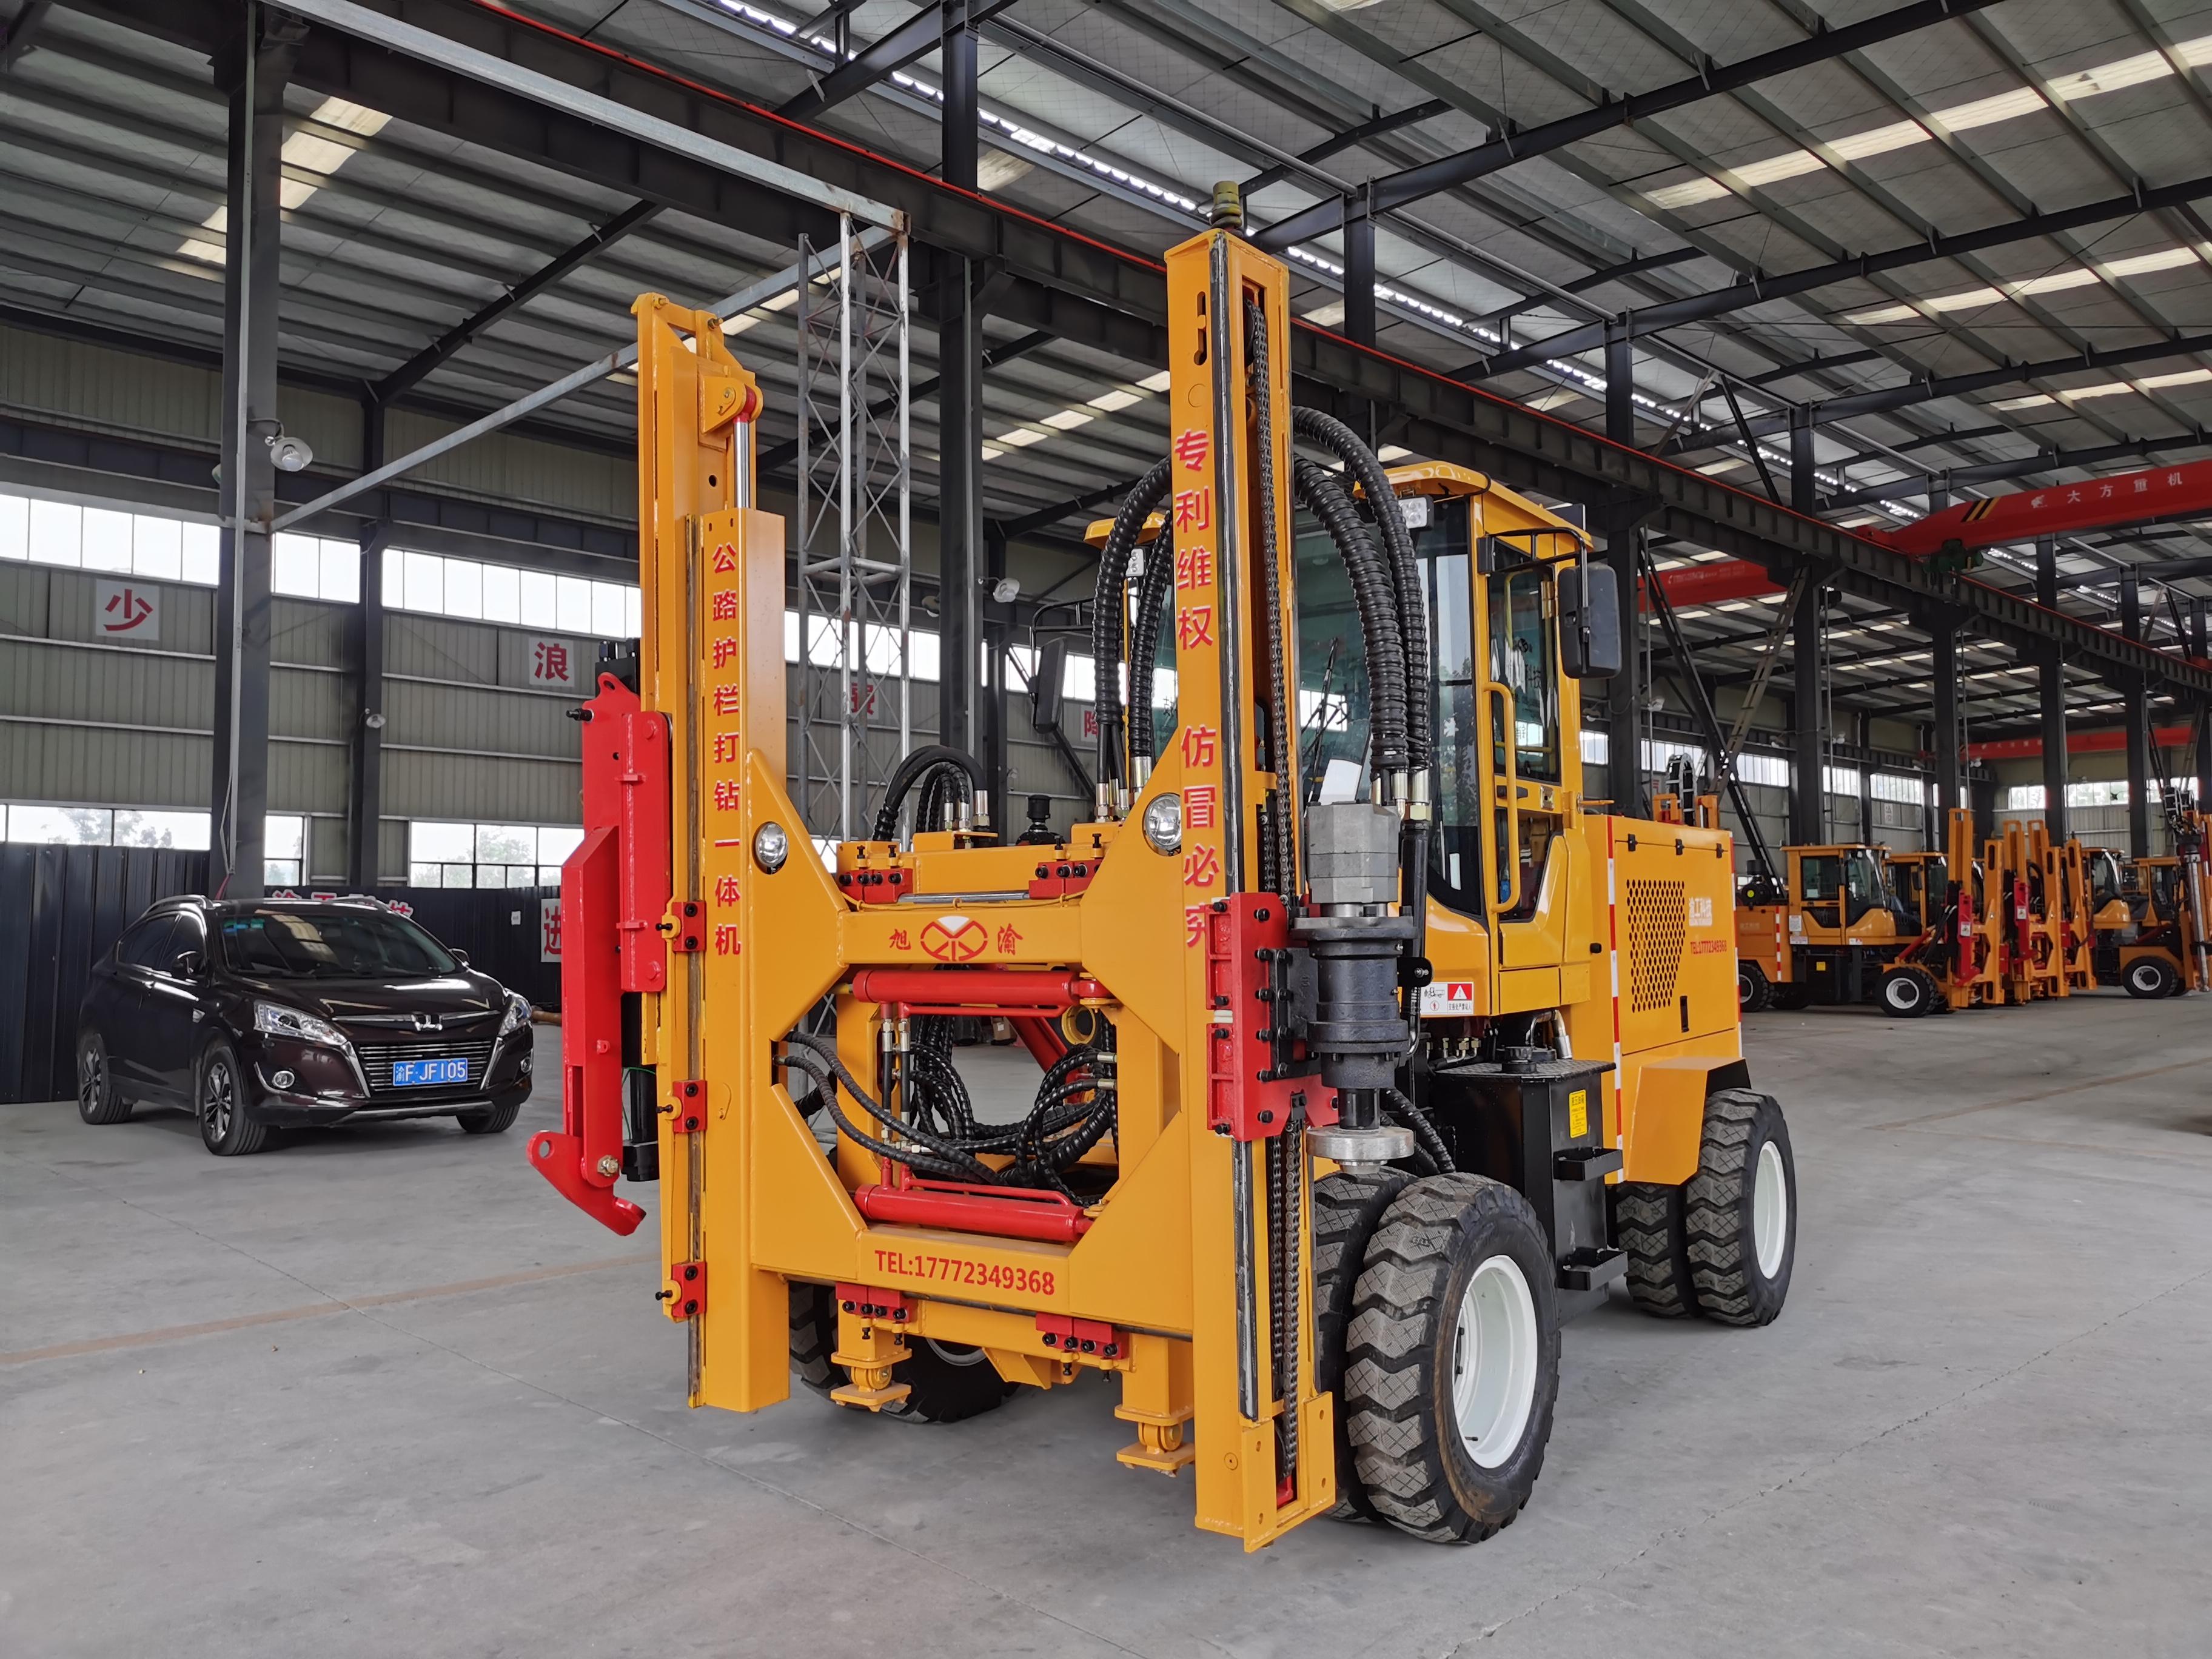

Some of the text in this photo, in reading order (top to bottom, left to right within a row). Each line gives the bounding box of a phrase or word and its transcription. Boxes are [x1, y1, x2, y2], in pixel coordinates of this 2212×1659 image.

[2066, 472, 2183, 504] 大方重机
[1175, 428, 1213, 651] 专利维权
[103, 588, 153, 631] 少
[534, 642, 569, 682] 浪
[712, 541, 742, 956] 公路护栏打钻一体机
[874, 1250, 1055, 1295] TEL:17772349368
